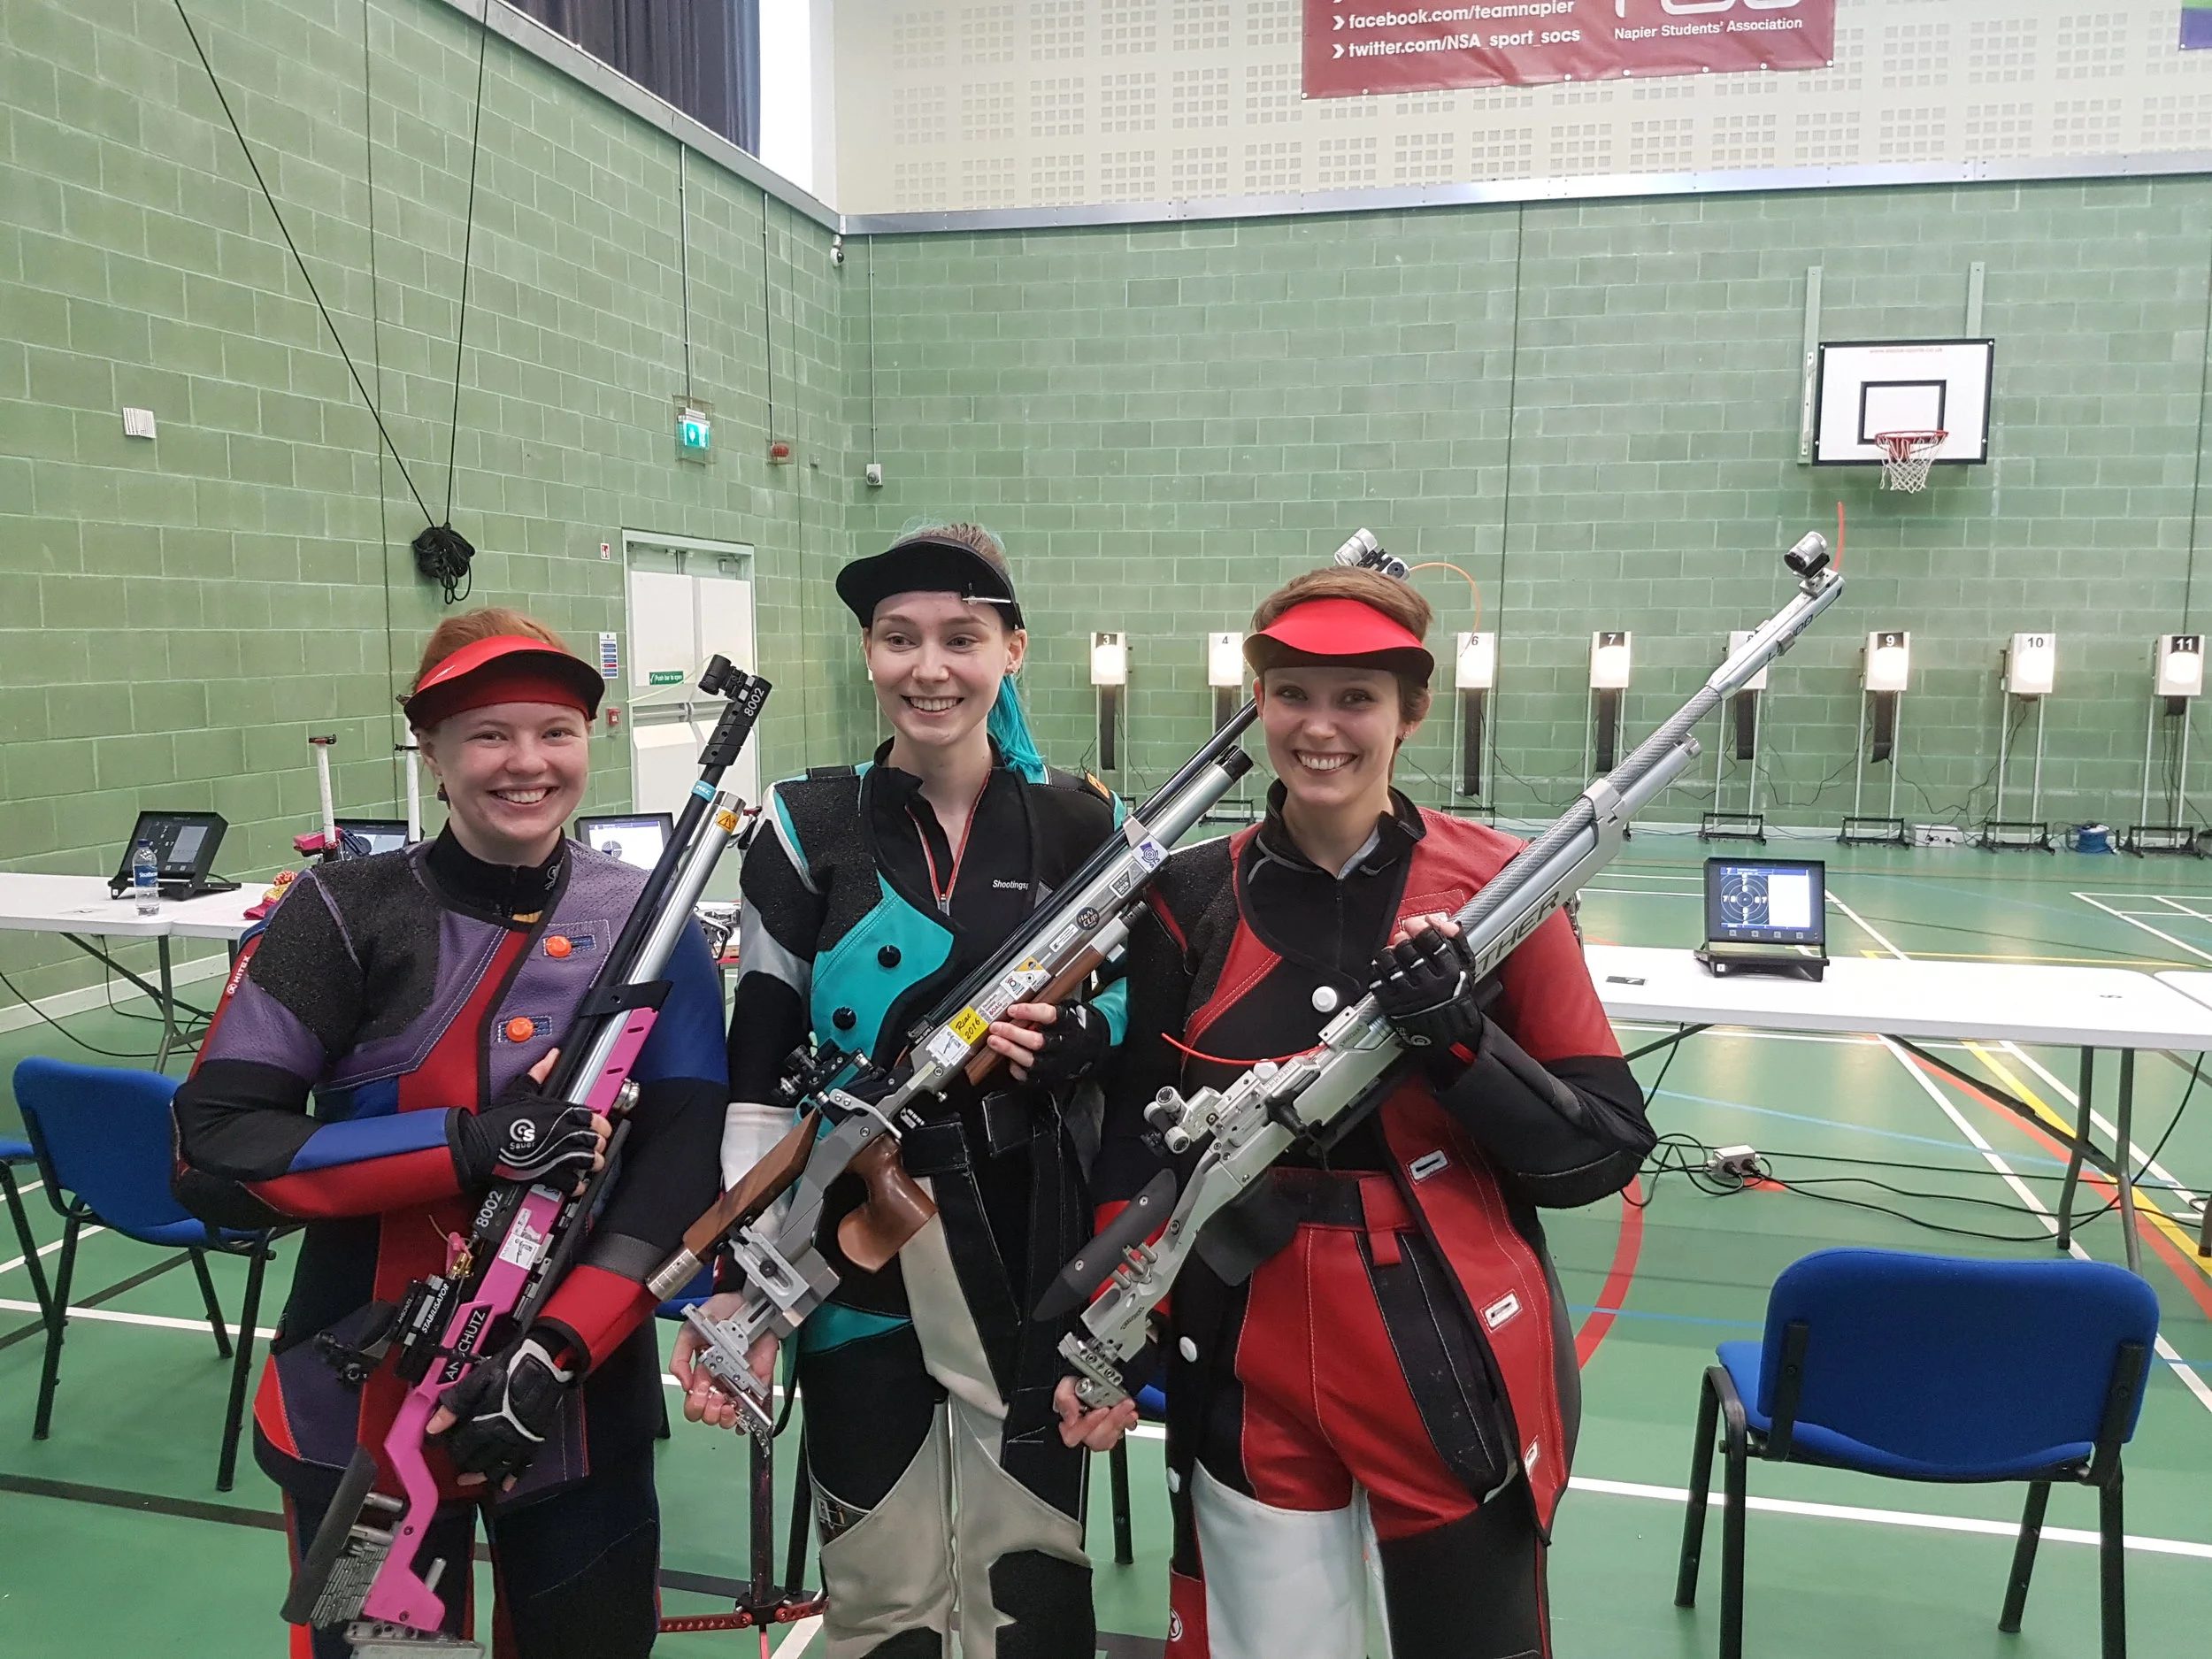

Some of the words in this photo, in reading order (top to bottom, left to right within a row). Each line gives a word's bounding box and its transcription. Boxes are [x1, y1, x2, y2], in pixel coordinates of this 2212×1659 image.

[1349, 1, 1575, 29] facebook.com/teamnapier
[1615, 27, 1657, 41] Napier
[1726, 19, 1802, 33] Association
[1348, 30, 1580, 57] twitter.com/NSA_sport_socs
[1103, 634, 1110, 645] 3
[1222, 635, 1229, 644] 4
[1471, 635, 1479, 646] 6
[1608, 634, 1616, 645] 7
[1886, 634, 1895, 647] 9
[2027, 636, 2044, 648] 10
[2177, 637, 2193, 650] 11
[744, 687, 764, 717] 8002
[965, 1018, 980, 1040] 2016
[510, 1141, 535, 1150] Sauer
[476, 1190, 503, 1227] 8002
[421, 1283, 449, 1333] STABILISATOR
[446, 1310, 486, 1380] ANCHUTZ
